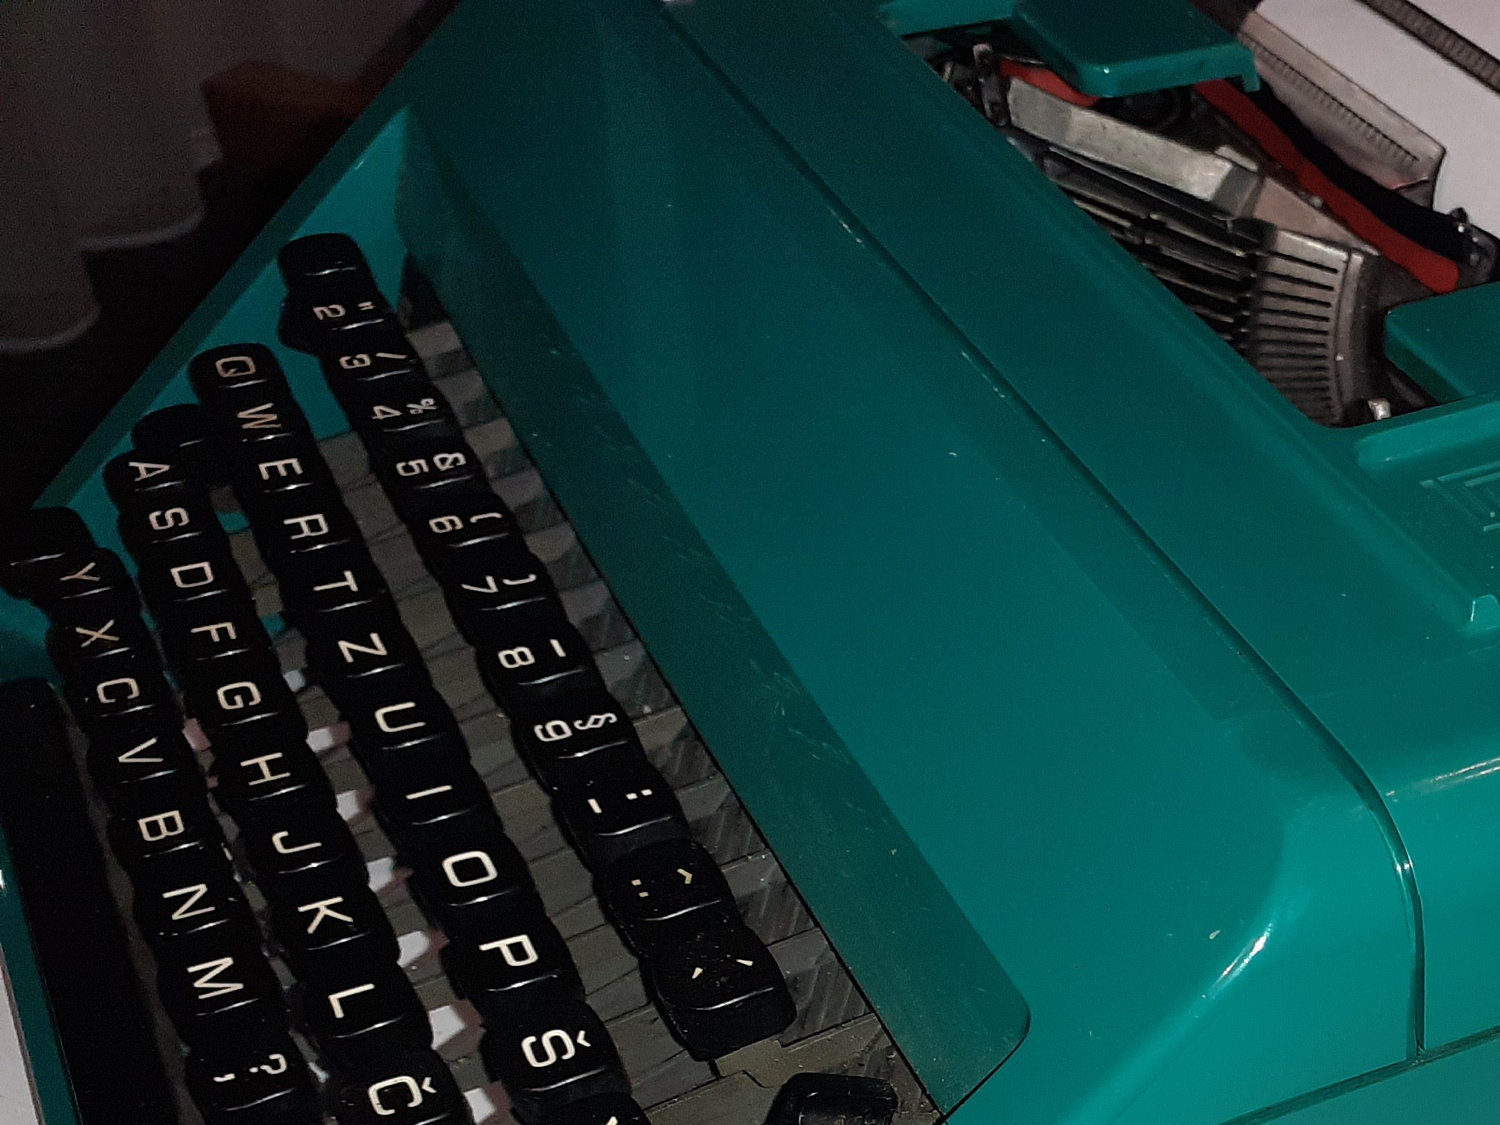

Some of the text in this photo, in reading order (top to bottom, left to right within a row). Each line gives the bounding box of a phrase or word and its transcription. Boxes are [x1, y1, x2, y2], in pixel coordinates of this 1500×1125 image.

[314, 305, 345, 319] 2
[216, 356, 255, 377] Q
[340, 354, 370, 368] 3
[238, 403, 280, 428] W
[373, 406, 401, 419] 4
[129, 462, 170, 481] A
[259, 459, 302, 479] E
[397, 459, 428, 476] 5
[149, 508, 188, 529] S
[284, 514, 328, 539] R
[429, 516, 463, 533] 6
[61, 563, 99, 581] Y
[171, 562, 213, 587] D
[314, 571, 358, 591] T
[462, 576, 498, 592] 7
[76, 620, 118, 646] X
[191, 622, 236, 641] F
[338, 633, 386, 662] Z
[499, 647, 534, 668] 8
[97, 678, 139, 703] C
[217, 682, 261, 709] G
[375, 702, 424, 732] U
[535, 720, 572, 741] 9
[119, 738, 163, 762] V
[241, 753, 290, 785] H
[407, 786, 451, 799] I
[138, 811, 184, 841] B
[272, 831, 321, 853] J
[443, 851, 497, 886] O
[163, 884, 214, 920] N
[298, 897, 353, 933] K
[480, 935, 538, 966] P
[188, 957, 243, 999] M
[329, 984, 374, 1018] L
[522, 1030, 590, 1067] Š
[369, 1076, 436, 1115] Č
